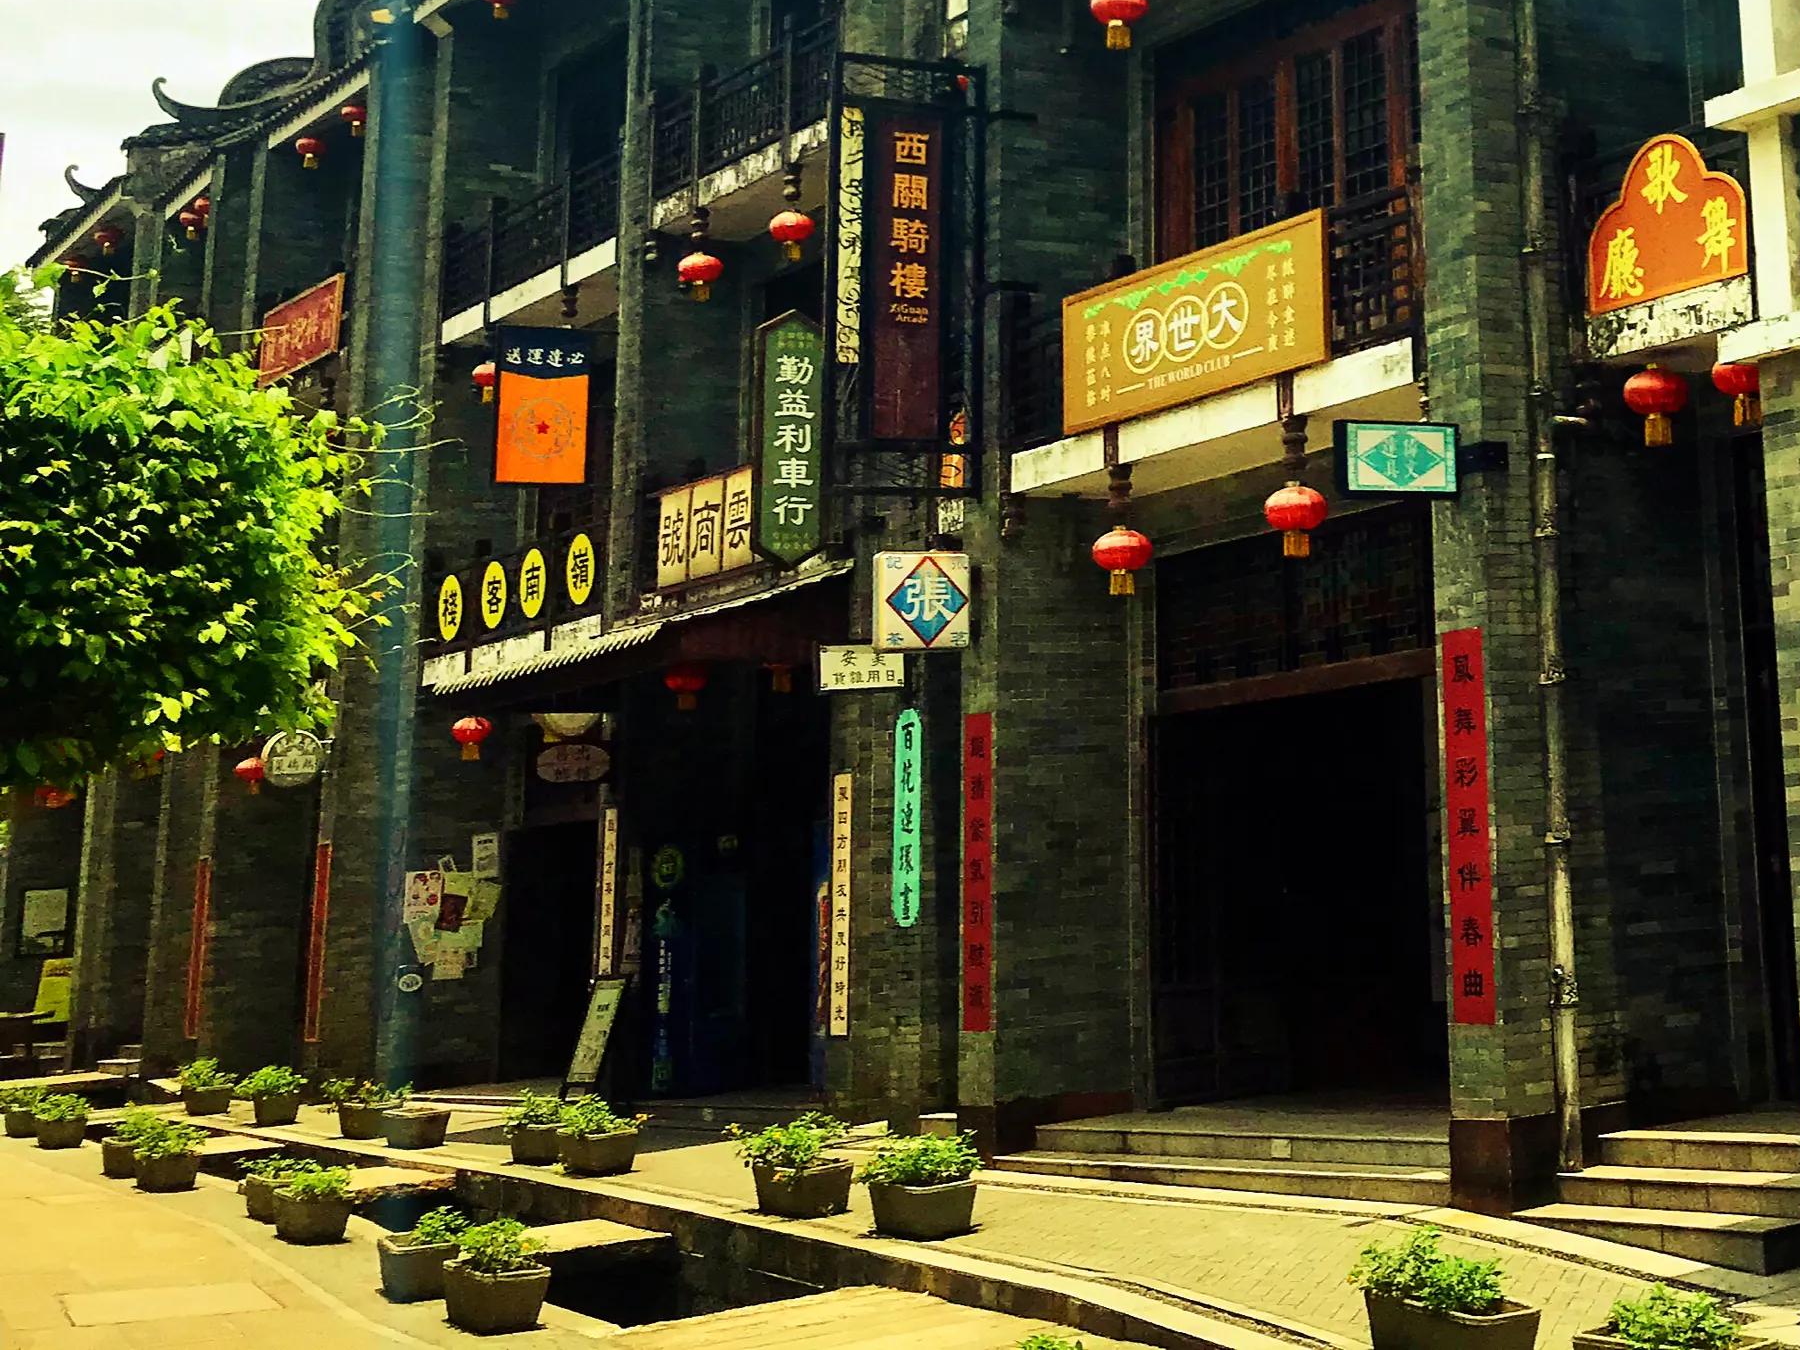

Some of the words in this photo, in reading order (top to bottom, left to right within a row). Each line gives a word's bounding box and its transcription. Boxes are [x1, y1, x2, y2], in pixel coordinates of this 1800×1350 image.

[889, 131, 930, 299] 西關騎樓
[1129, 289, 1243, 364] 大世界
[1147, 374, 1168, 390] THE
[1168, 363, 1204, 385] WORLD
[772, 354, 816, 526] 勤益利車行
[901, 576, 957, 621] 張
